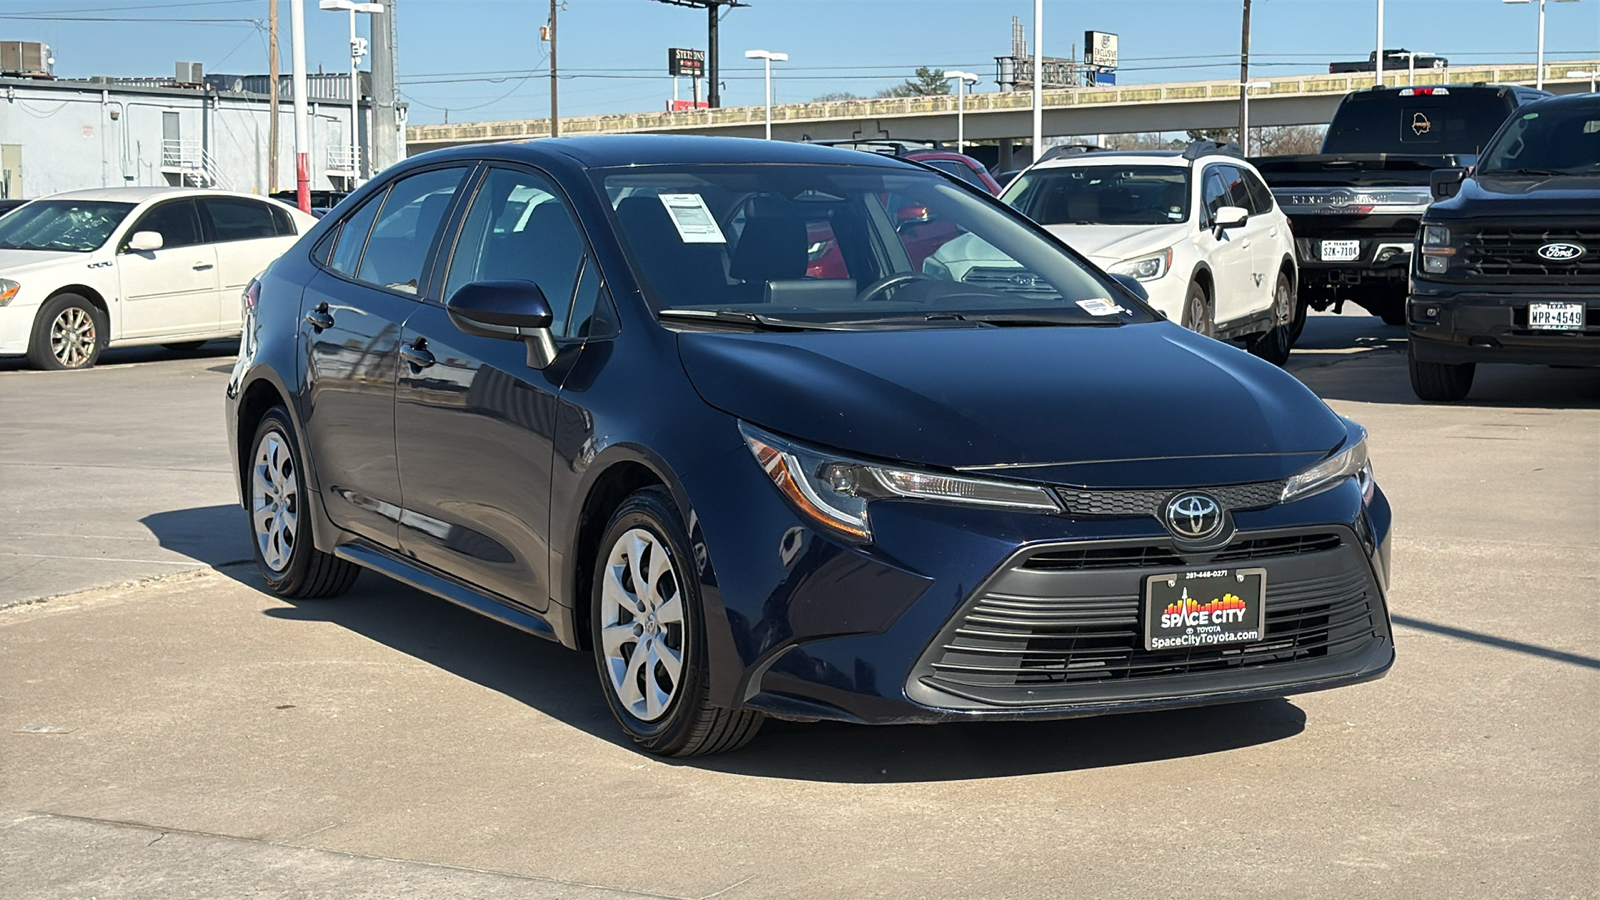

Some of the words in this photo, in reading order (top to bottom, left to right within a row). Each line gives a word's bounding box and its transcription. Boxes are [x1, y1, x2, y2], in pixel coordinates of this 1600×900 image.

[1324, 247, 1357, 256] SZK-7104
[1546, 246, 1574, 257] Ford
[1532, 311, 1581, 324] WPR-4549
[1161, 611, 1209, 628] SPACE
[1212, 608, 1246, 623] CITY
[1151, 631, 1258, 648] SpaceCityToyota.com
